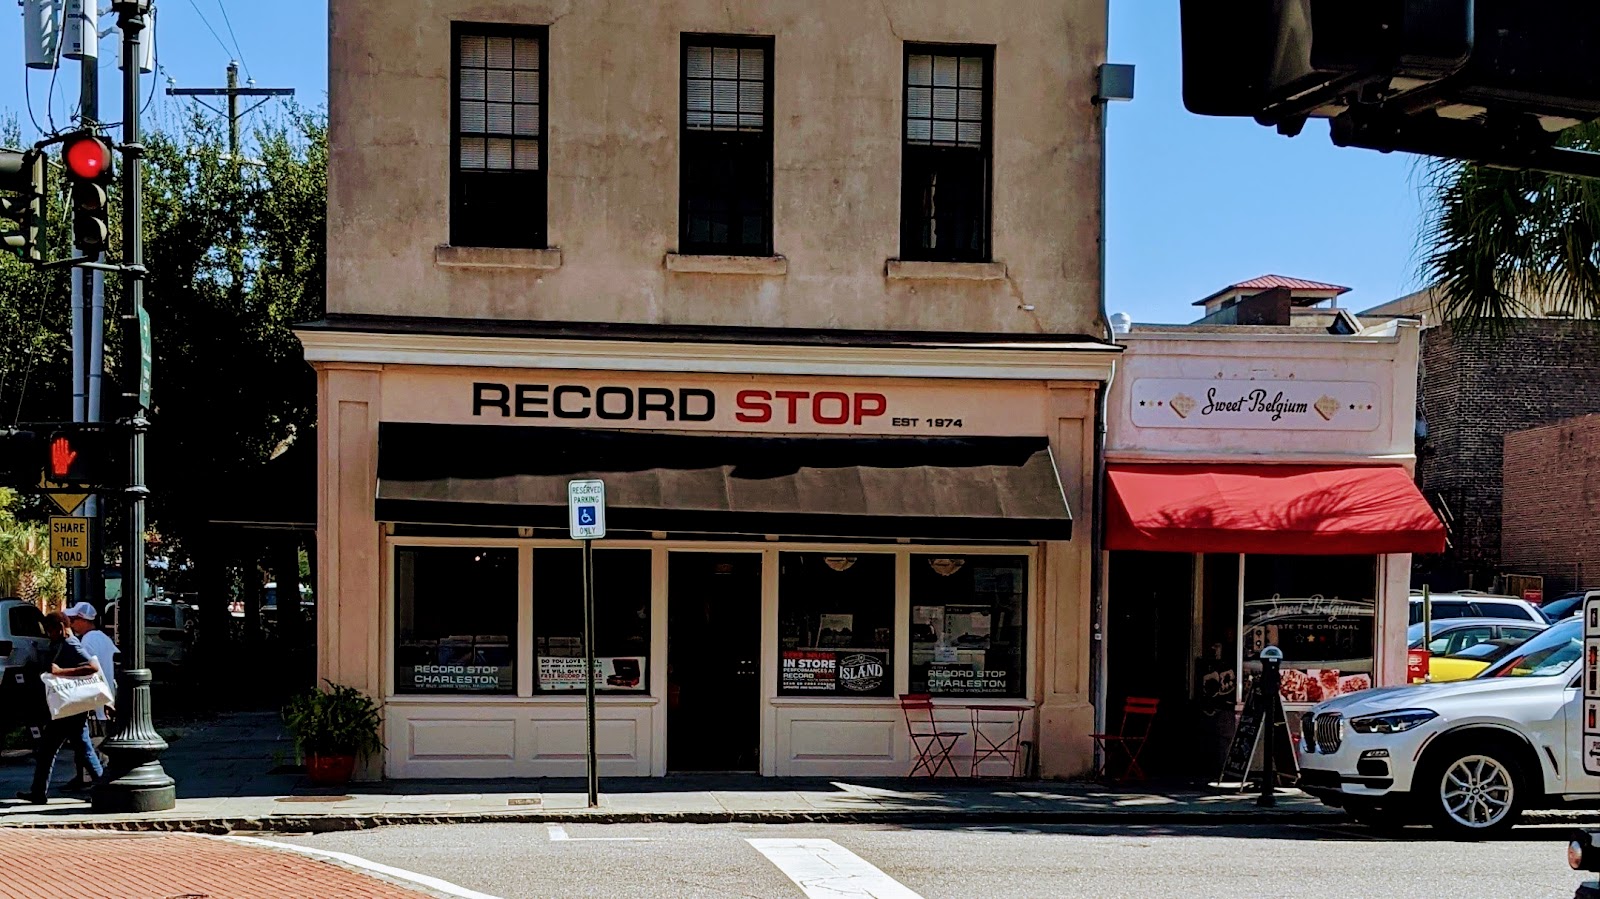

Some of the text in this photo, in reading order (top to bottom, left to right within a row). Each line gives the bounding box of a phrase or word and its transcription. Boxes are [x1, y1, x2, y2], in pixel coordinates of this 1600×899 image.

[472, 382, 963, 428] RECORD STOP EST 1974
[1201, 387, 1308, 422] Sweet Belgium
[572, 485, 601, 494] RESERVED
[573, 495, 600, 504] PARKING
[53, 522, 85, 533] SHARE
[580, 526, 596, 535] ONLY
[60, 537, 79, 547] THE
[56, 551, 82, 562] ROAD
[1266, 593, 1360, 622] Sweet Belgium
[783, 658, 837, 669] IN STORE
[414, 665, 499, 674] RECORD STOP
[839, 663, 884, 680] ISLAND
[927, 670, 1007, 678] RECORD STOP
[414, 675, 499, 684] CHARLESTON
[927, 680, 1007, 688] CHARLESTON
